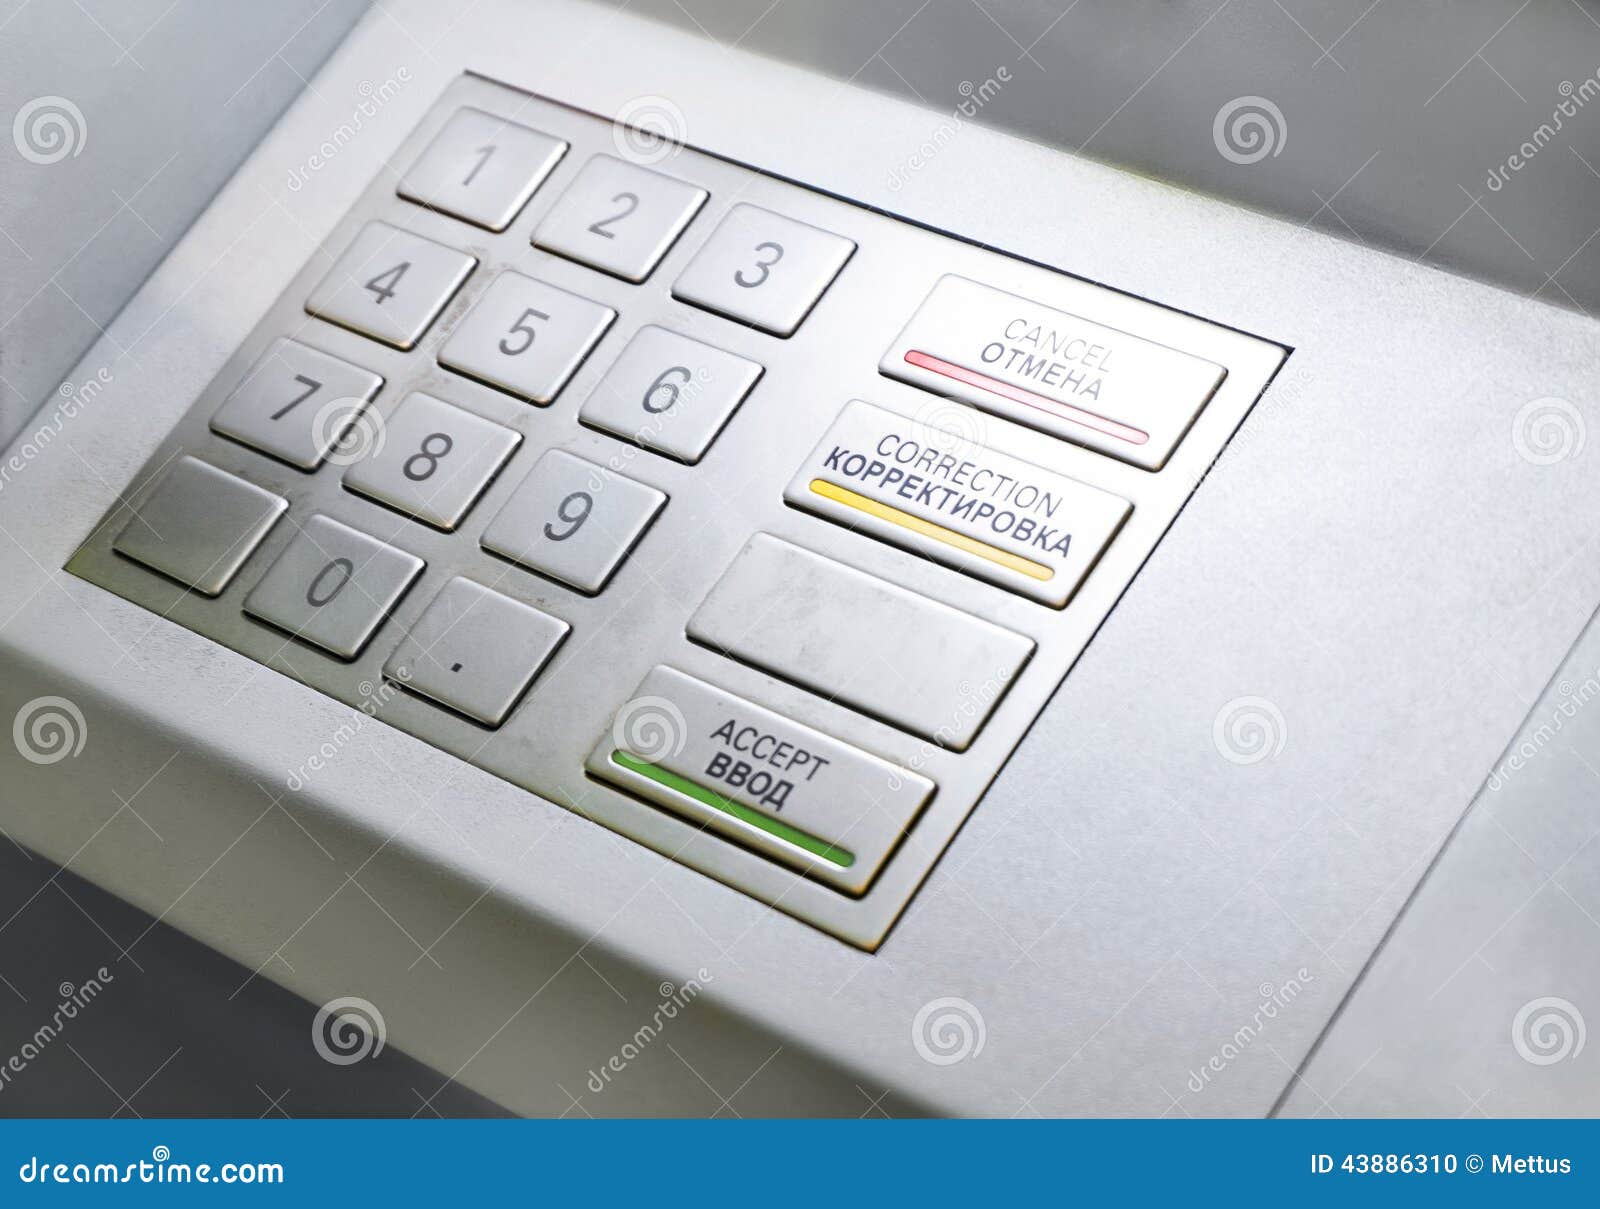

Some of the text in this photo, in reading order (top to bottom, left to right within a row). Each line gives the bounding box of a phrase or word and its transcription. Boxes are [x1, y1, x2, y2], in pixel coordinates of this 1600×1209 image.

[462, 145, 497, 188] 1
[586, 191, 640, 240] 2
[363, 260, 411, 305] 4
[733, 241, 785, 289] 3
[498, 307, 550, 357] 5
[1003, 318, 1113, 374] CANCEL
[641, 365, 692, 415] 6
[979, 342, 1103, 401] ОТМЕНА
[268, 374, 323, 422] 7
[402, 432, 454, 482] 8
[876, 434, 1063, 518] CORRECTION
[542, 491, 594, 542] 9
[823, 446, 1072, 558] КОРРЕКТИРОВКА
[305, 557, 354, 608] 0
[709, 719, 830, 781] ACCEPT
[704, 751, 795, 812] ВВОД
